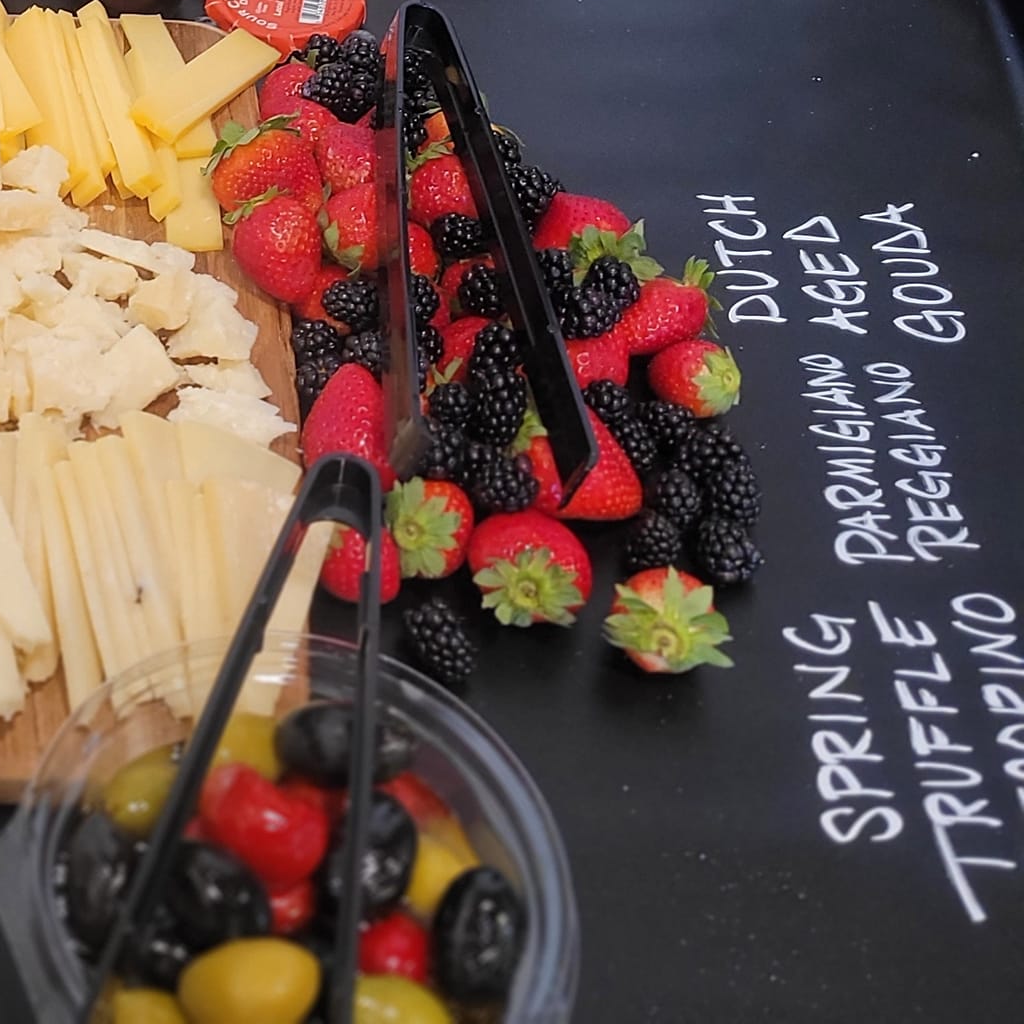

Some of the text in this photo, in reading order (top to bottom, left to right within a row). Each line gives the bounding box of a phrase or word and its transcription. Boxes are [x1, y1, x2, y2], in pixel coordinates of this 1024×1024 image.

[238, 10, 277, 29] SOUR
[696, 194, 788, 323] DUTCH
[783, 215, 869, 335] AGED
[859, 203, 967, 343] GOUDA
[799, 353, 915, 565] PARMIGIANO
[862, 361, 981, 562] REGGIANO
[782, 613, 904, 843] SPRING
[868, 600, 1017, 923] TRUFFLE
